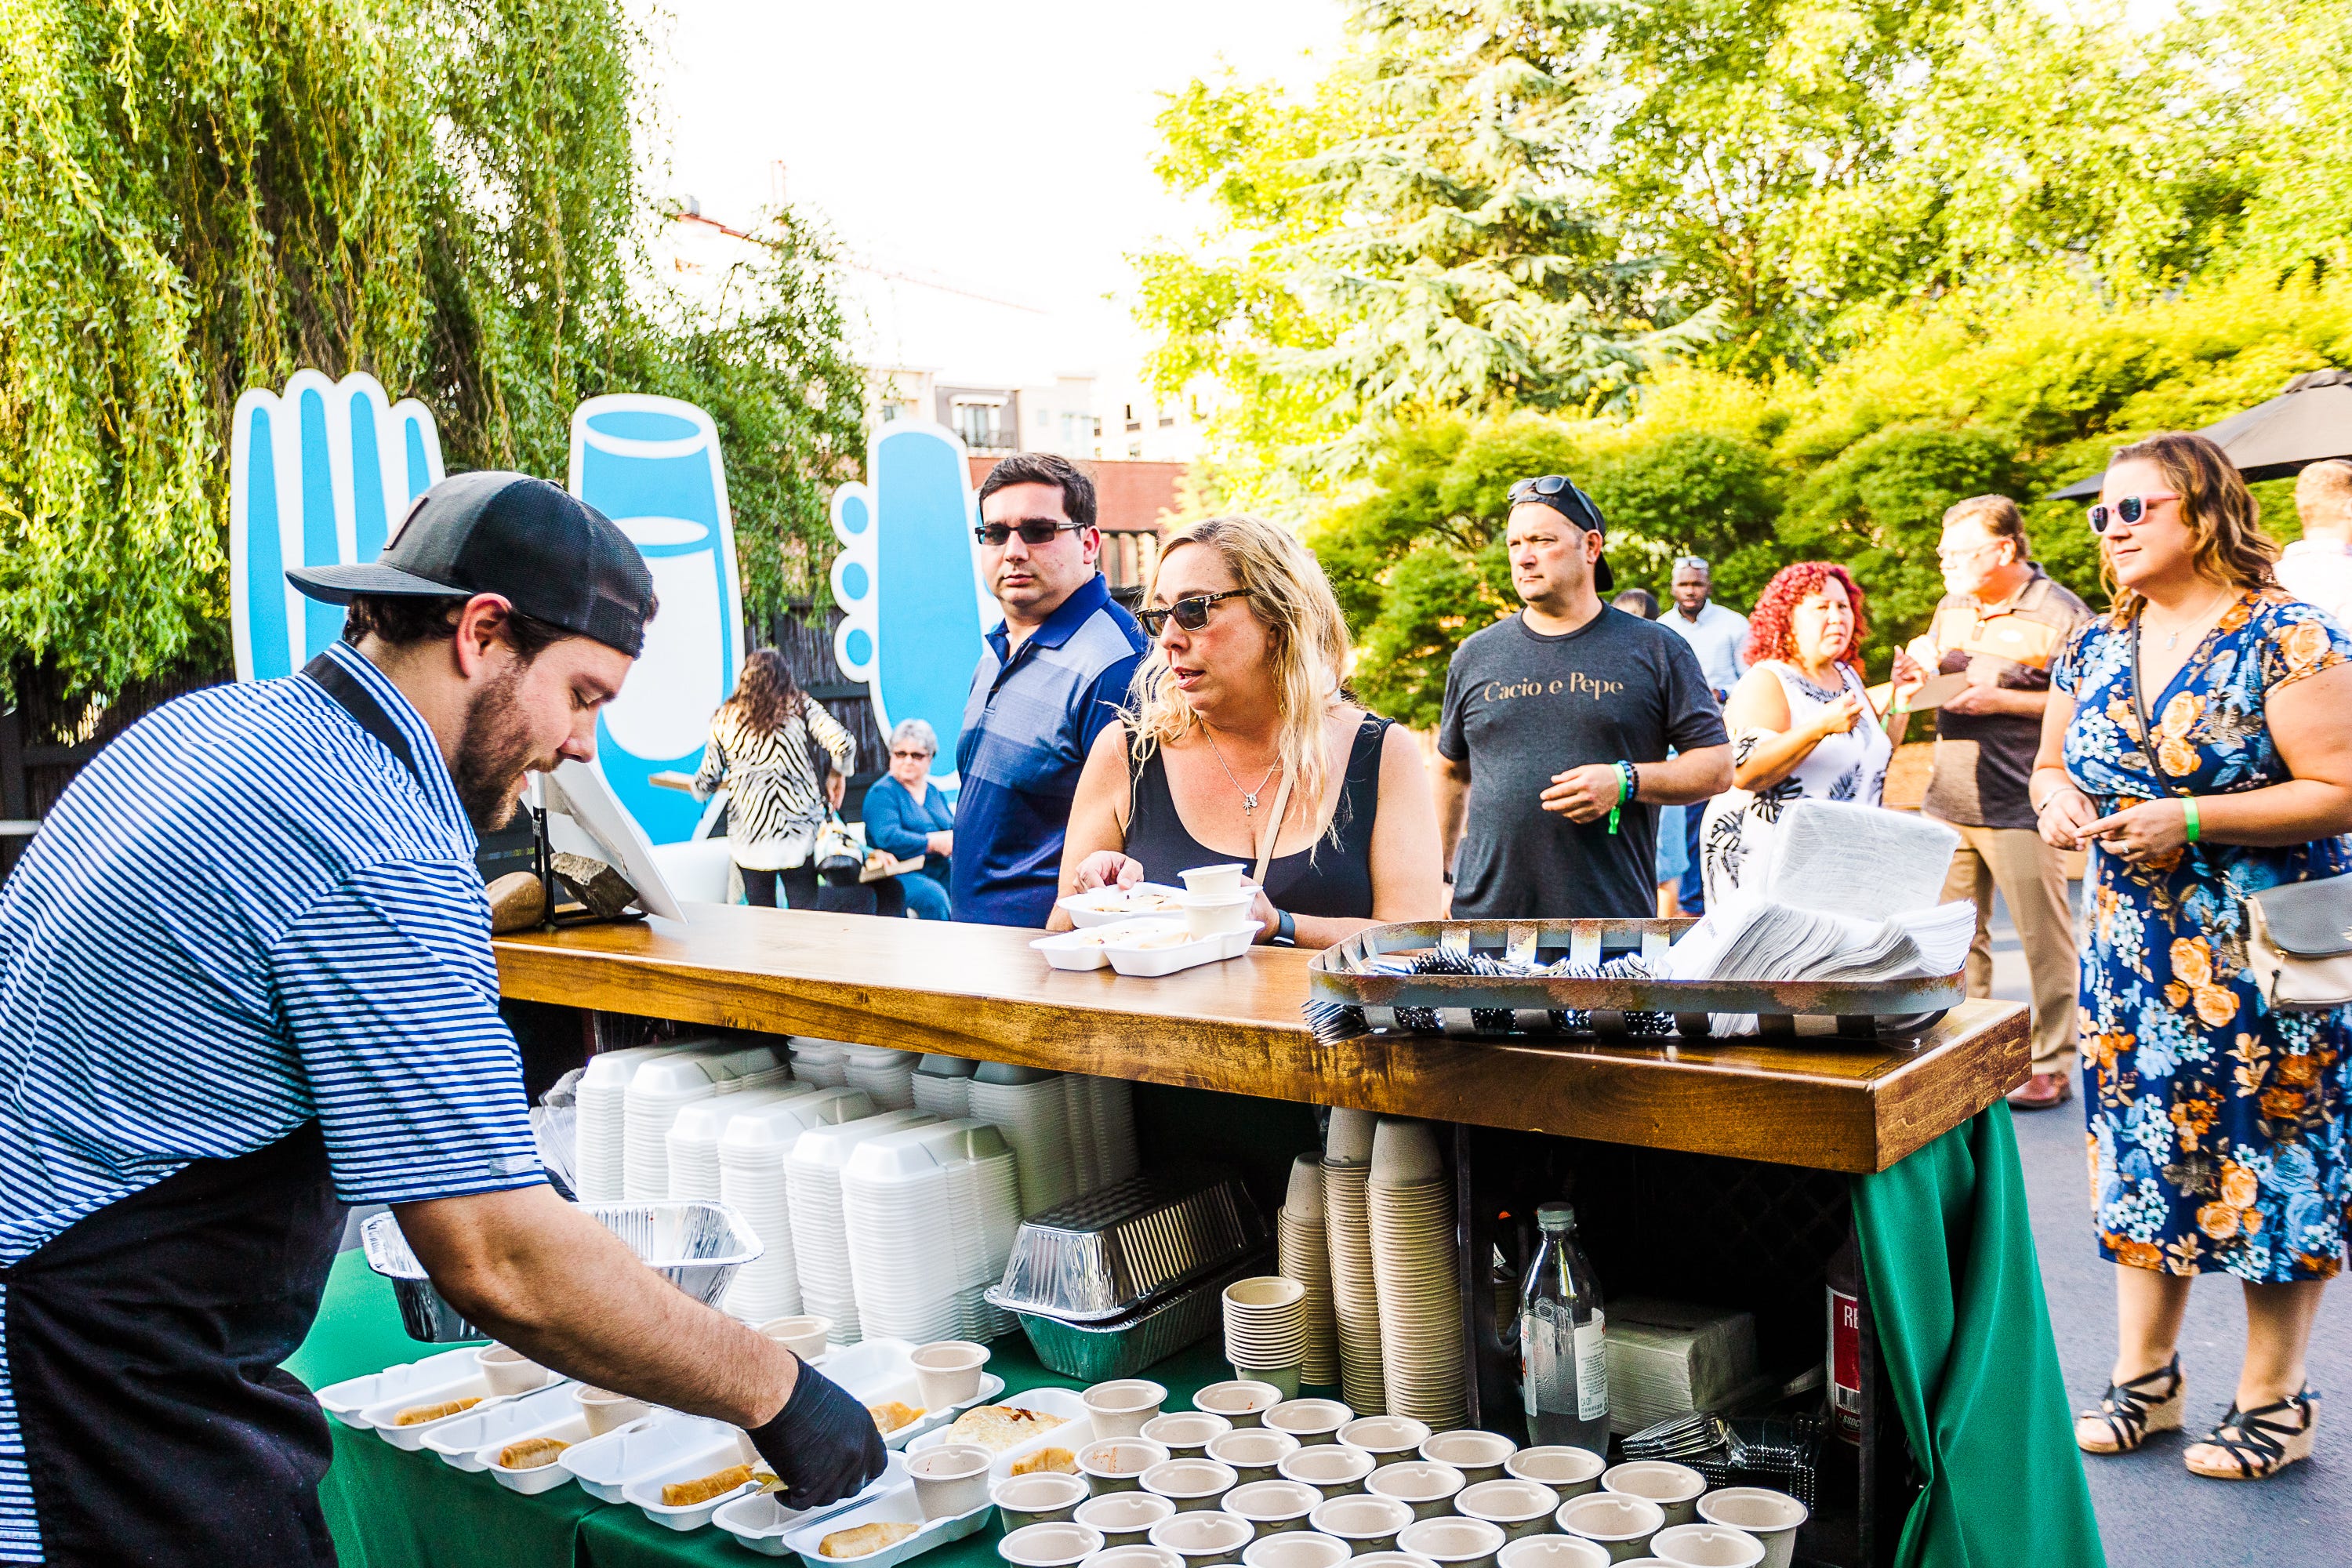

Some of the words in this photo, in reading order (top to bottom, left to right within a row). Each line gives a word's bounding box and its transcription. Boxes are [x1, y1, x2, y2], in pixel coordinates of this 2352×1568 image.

[1483, 677, 1542, 702] Cacio
[1549, 680, 1563, 695] e
[1570, 673, 1624, 700] Pepe
